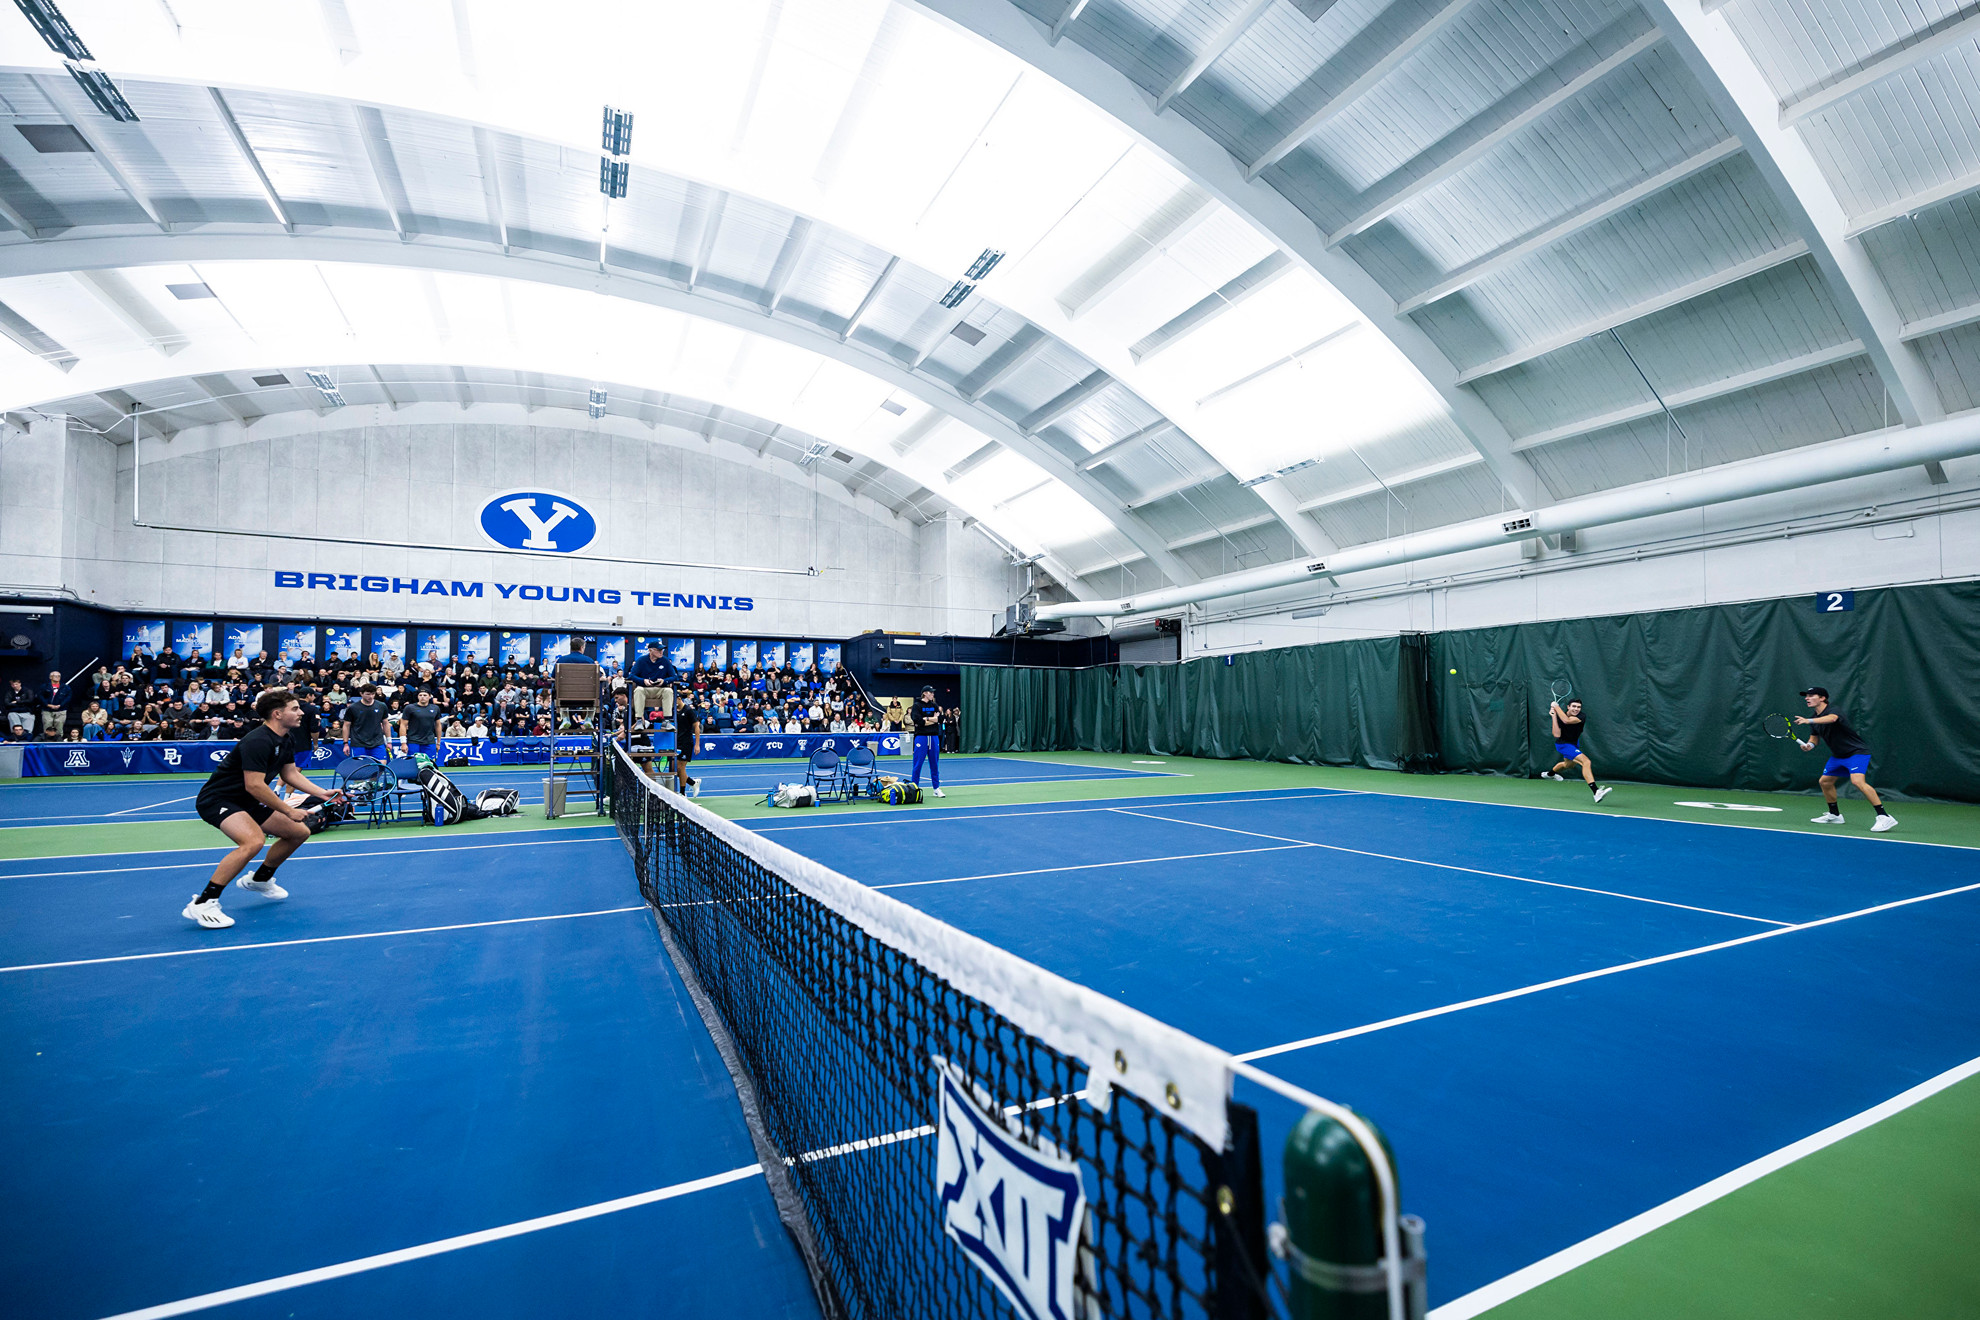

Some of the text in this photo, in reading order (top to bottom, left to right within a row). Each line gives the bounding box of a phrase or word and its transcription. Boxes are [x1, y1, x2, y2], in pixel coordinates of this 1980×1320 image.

[500, 498, 579, 549] Y
[275, 571, 754, 612] BRIGHAM YOUNG TENNIS
[1827, 593, 1844, 611] 2
[446, 743, 482, 760] XII
[732, 741, 751, 752] OSU
[766, 741, 784, 751] TCU
[64, 749, 90, 768] A
[163, 748, 182, 765] BU
[943, 1088, 1068, 1318] XII
